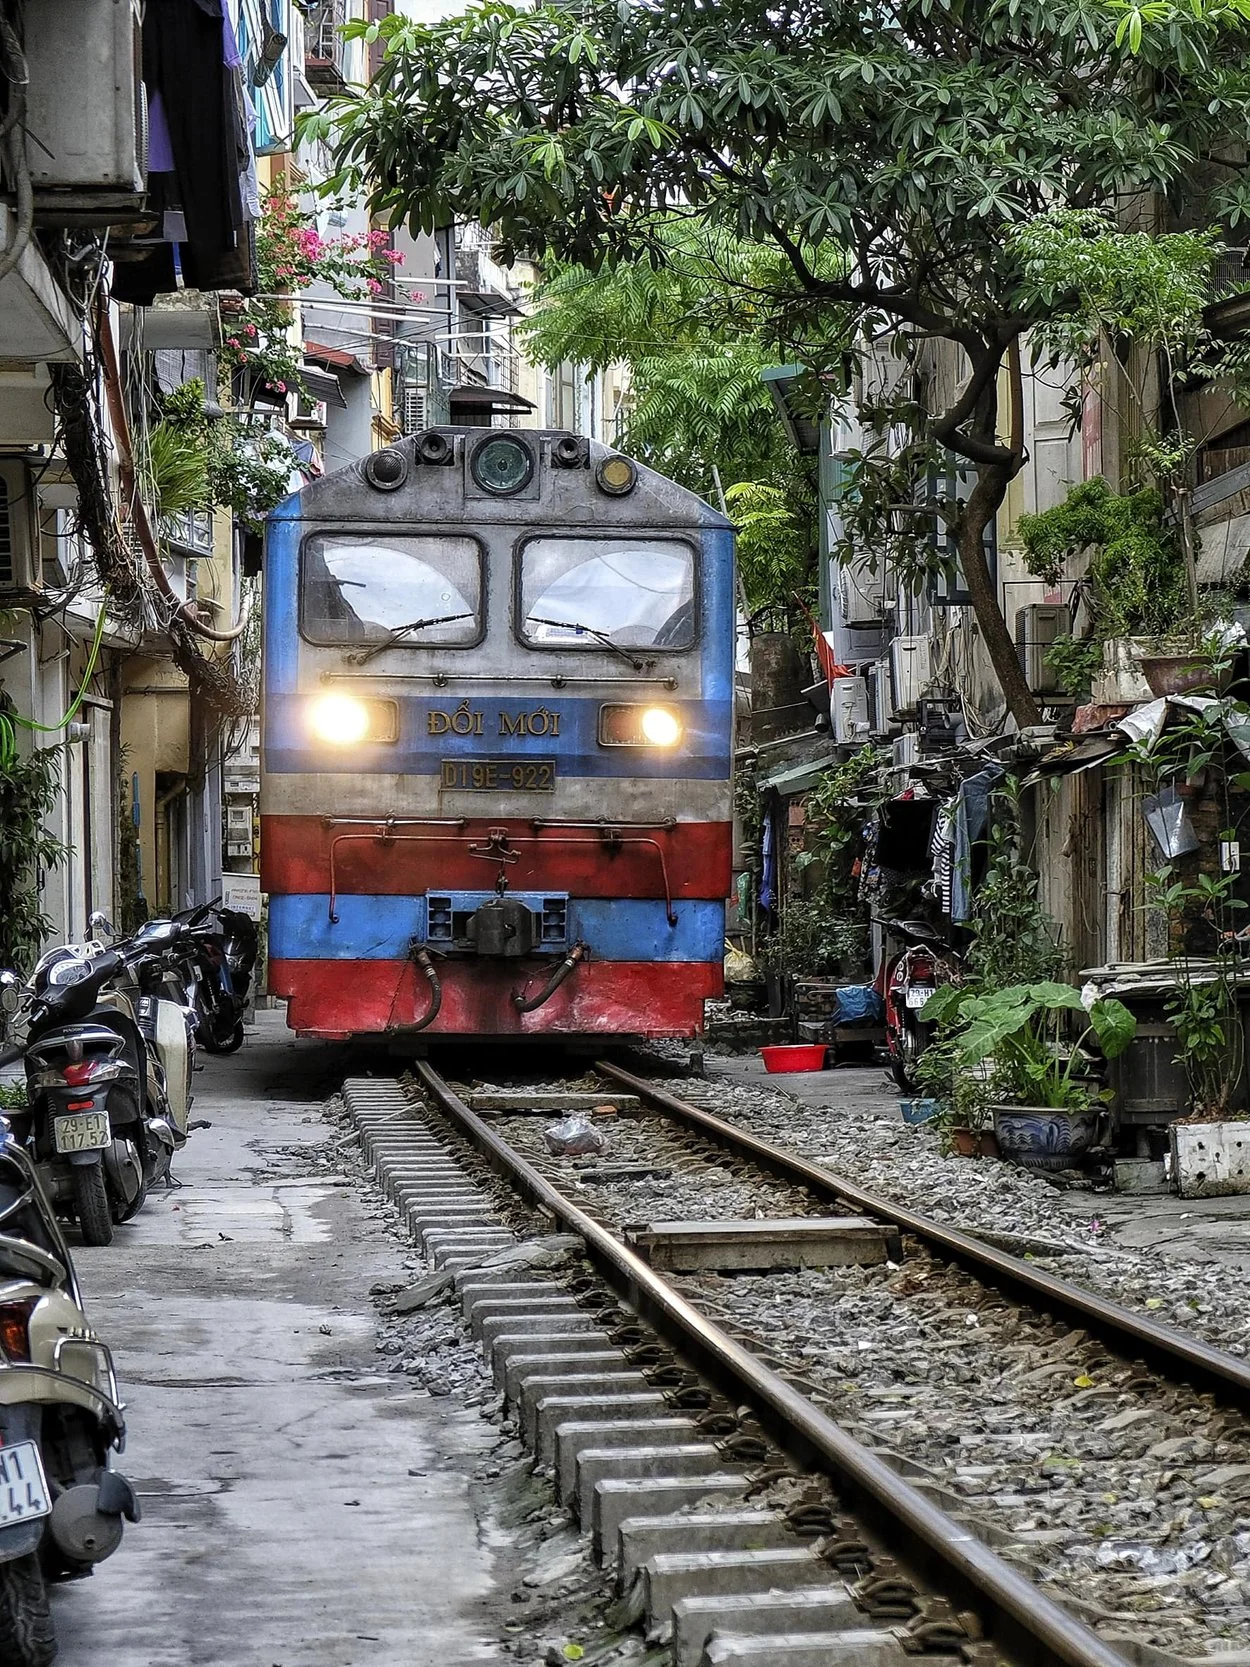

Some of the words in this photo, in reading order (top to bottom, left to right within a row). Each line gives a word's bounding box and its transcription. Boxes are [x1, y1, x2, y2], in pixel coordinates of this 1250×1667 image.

[428, 699, 484, 735] ĐỔI
[499, 705, 561, 735] MỚI
[443, 763, 551, 790] D19E-922
